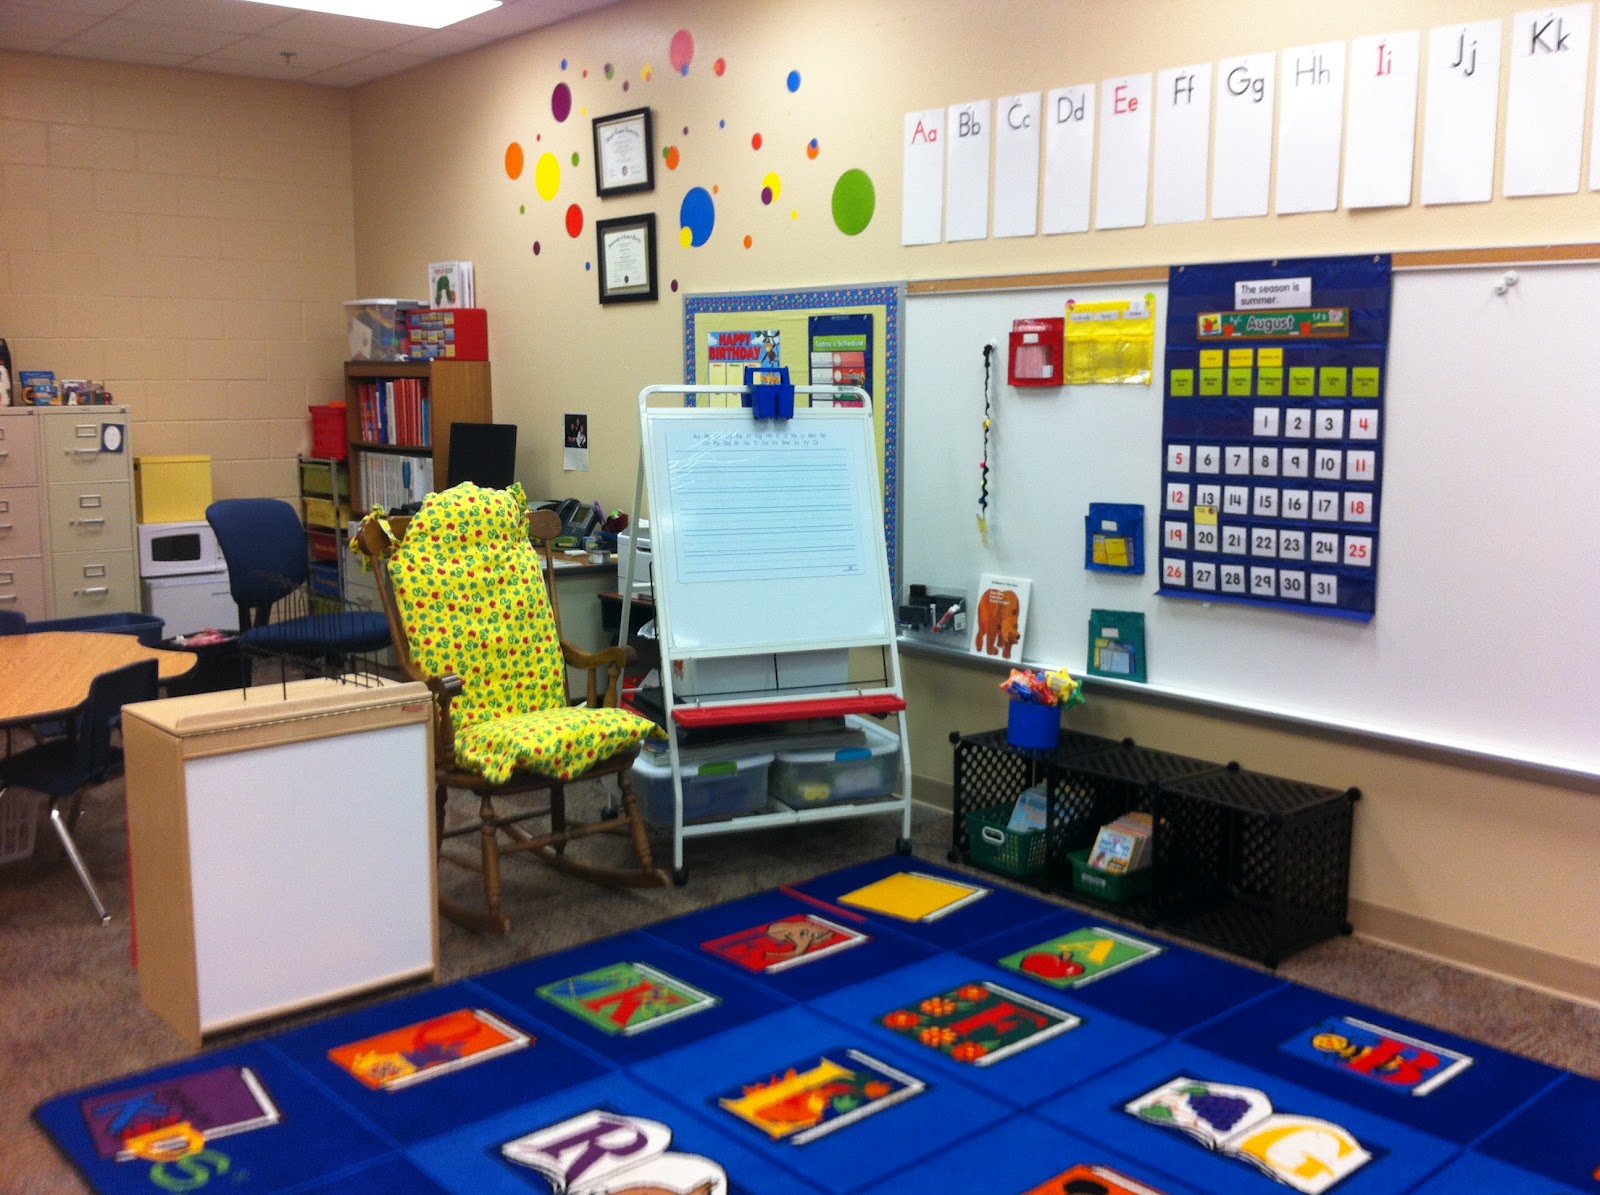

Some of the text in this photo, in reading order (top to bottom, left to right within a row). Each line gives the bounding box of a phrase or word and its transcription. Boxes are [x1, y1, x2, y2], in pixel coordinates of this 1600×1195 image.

[1531, 19, 1569, 55] Kk
[1376, 44, 1392, 77] Ii
[1451, 34, 1477, 78] Jj
[1295, 55, 1330, 87] Hh
[1173, 74, 1195, 105] Ff
[1226, 66, 1265, 104] Gg
[1114, 85, 1139, 115] Ee
[1007, 103, 1031, 131] Cc
[1057, 95, 1086, 124] Dd
[958, 111, 982, 138] Bb
[911, 120, 938, 145] Aa
[1241, 283, 1300, 295] The season is
[1247, 315, 1294, 332] August
[719, 333, 751, 345] HAPPY
[709, 346, 761, 361] BIRTHDAY
[1293, 416, 1302, 431] 2
[1324, 417, 1334, 431] 3
[1359, 418, 1369, 431] 4
[1175, 452, 1183, 465] 5
[1203, 453, 1212, 467] 6
[1233, 454, 1241, 467] 7
[1261, 455, 1270, 469] 8
[1291, 456, 1300, 469] 9
[1320, 457, 1335, 472] 10
[1355, 459, 1366, 472] 11
[1171, 490, 1184, 504] 12
[1202, 492, 1215, 505] 13
[1229, 493, 1242, 507] 14
[1259, 495, 1272, 509] 15
[1288, 497, 1302, 511] 16
[1318, 499, 1332, 513] 17
[1350, 500, 1365, 515] 18
[1170, 529, 1183, 541] 19
[1198, 531, 1214, 545] 20
[1228, 533, 1241, 547] 21
[1255, 535, 1272, 550] 22
[1283, 537, 1301, 552] 23
[1315, 540, 1334, 555] 24
[1348, 543, 1367, 559] 25
[1166, 565, 1182, 579] 26
[1196, 569, 1212, 582] 27
[1224, 572, 1241, 586] 28
[1254, 574, 1272, 589] 29
[1283, 577, 1301, 592] 30
[1317, 581, 1331, 596] 31
[948, 1001, 1048, 1036] F
[1336, 1035, 1440, 1085] B
[531, 1119, 648, 1183] R
[1241, 1124, 1355, 1180] G
